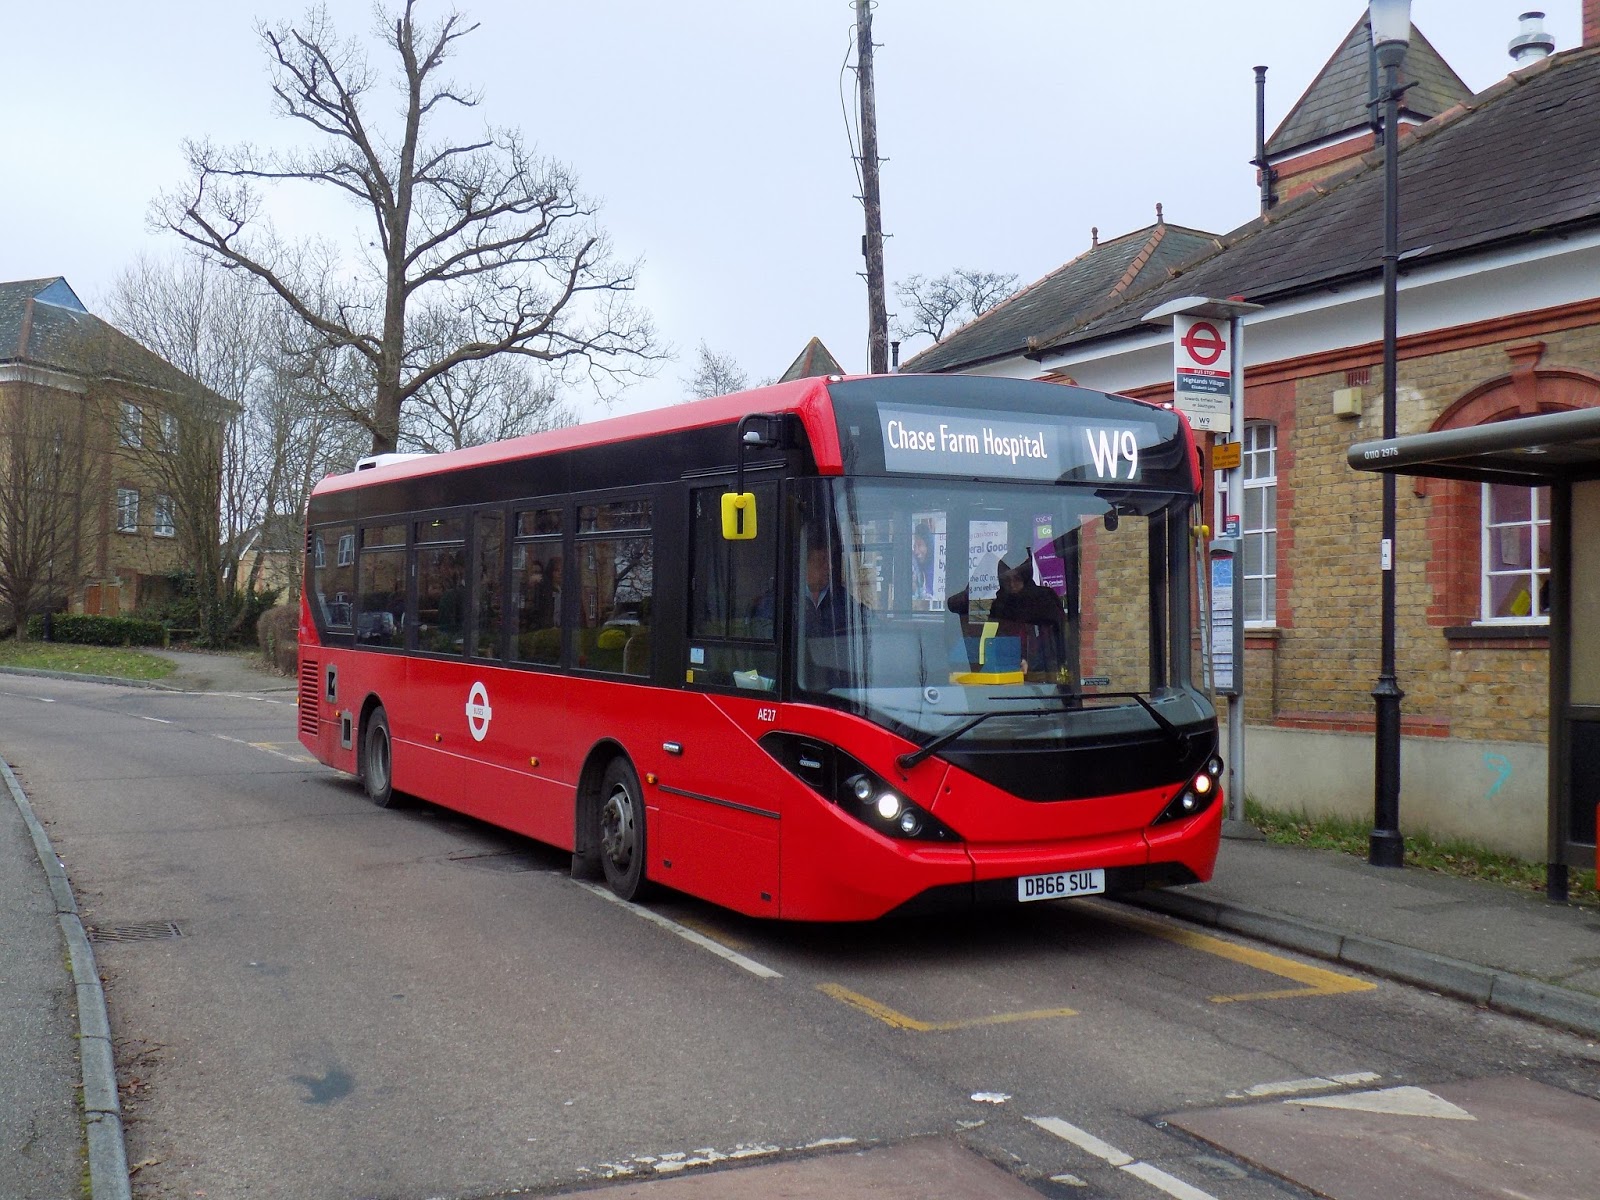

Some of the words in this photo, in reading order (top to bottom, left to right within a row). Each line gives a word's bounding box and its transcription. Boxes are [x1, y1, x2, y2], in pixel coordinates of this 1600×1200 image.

[888, 420, 935, 451] Chase
[940, 424, 980, 454] Farm
[982, 428, 1047, 464] Hospital
[1086, 429, 1138, 479] W9
[1364, 449, 1379, 460] 0110
[757, 708, 776, 722] AE27
[1025, 876, 1065, 896] DB66
[1070, 872, 1098, 891] SUL
